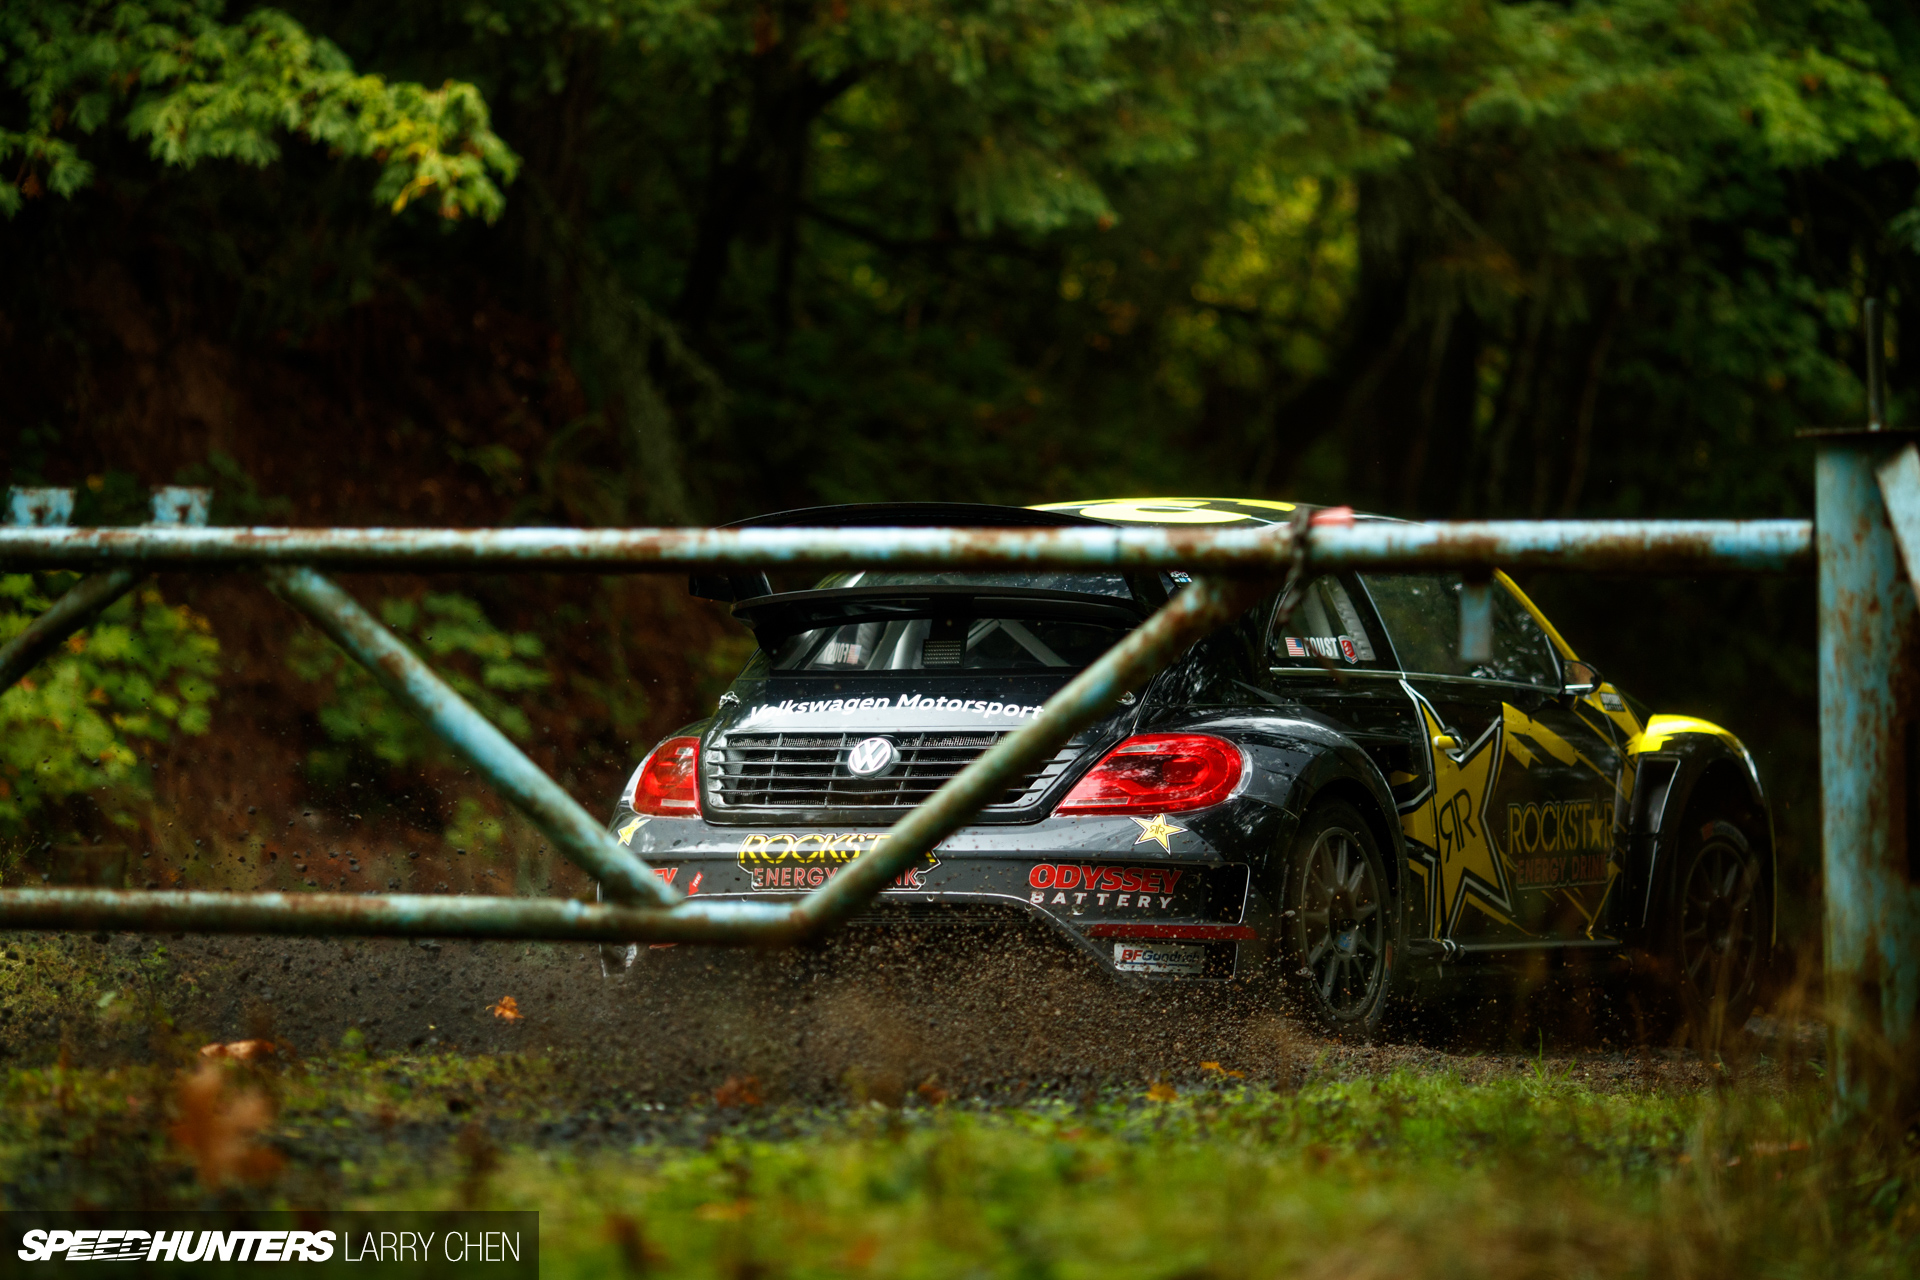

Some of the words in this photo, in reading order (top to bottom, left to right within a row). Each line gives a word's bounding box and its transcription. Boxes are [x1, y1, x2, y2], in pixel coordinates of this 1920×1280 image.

[1304, 637, 1339, 657] FOUST
[750, 696, 891, 720] Volkswagen
[895, 694, 1045, 721] Motorsport
[739, 834, 937, 864] ROCKST
[1029, 864, 1183, 894] ODYSSEY
[1518, 857, 1567, 884] ENERGY
[1571, 854, 1608, 880] DRINK
[1030, 892, 1173, 909] BATTERY
[1121, 949, 1200, 963] BFGoodrich
